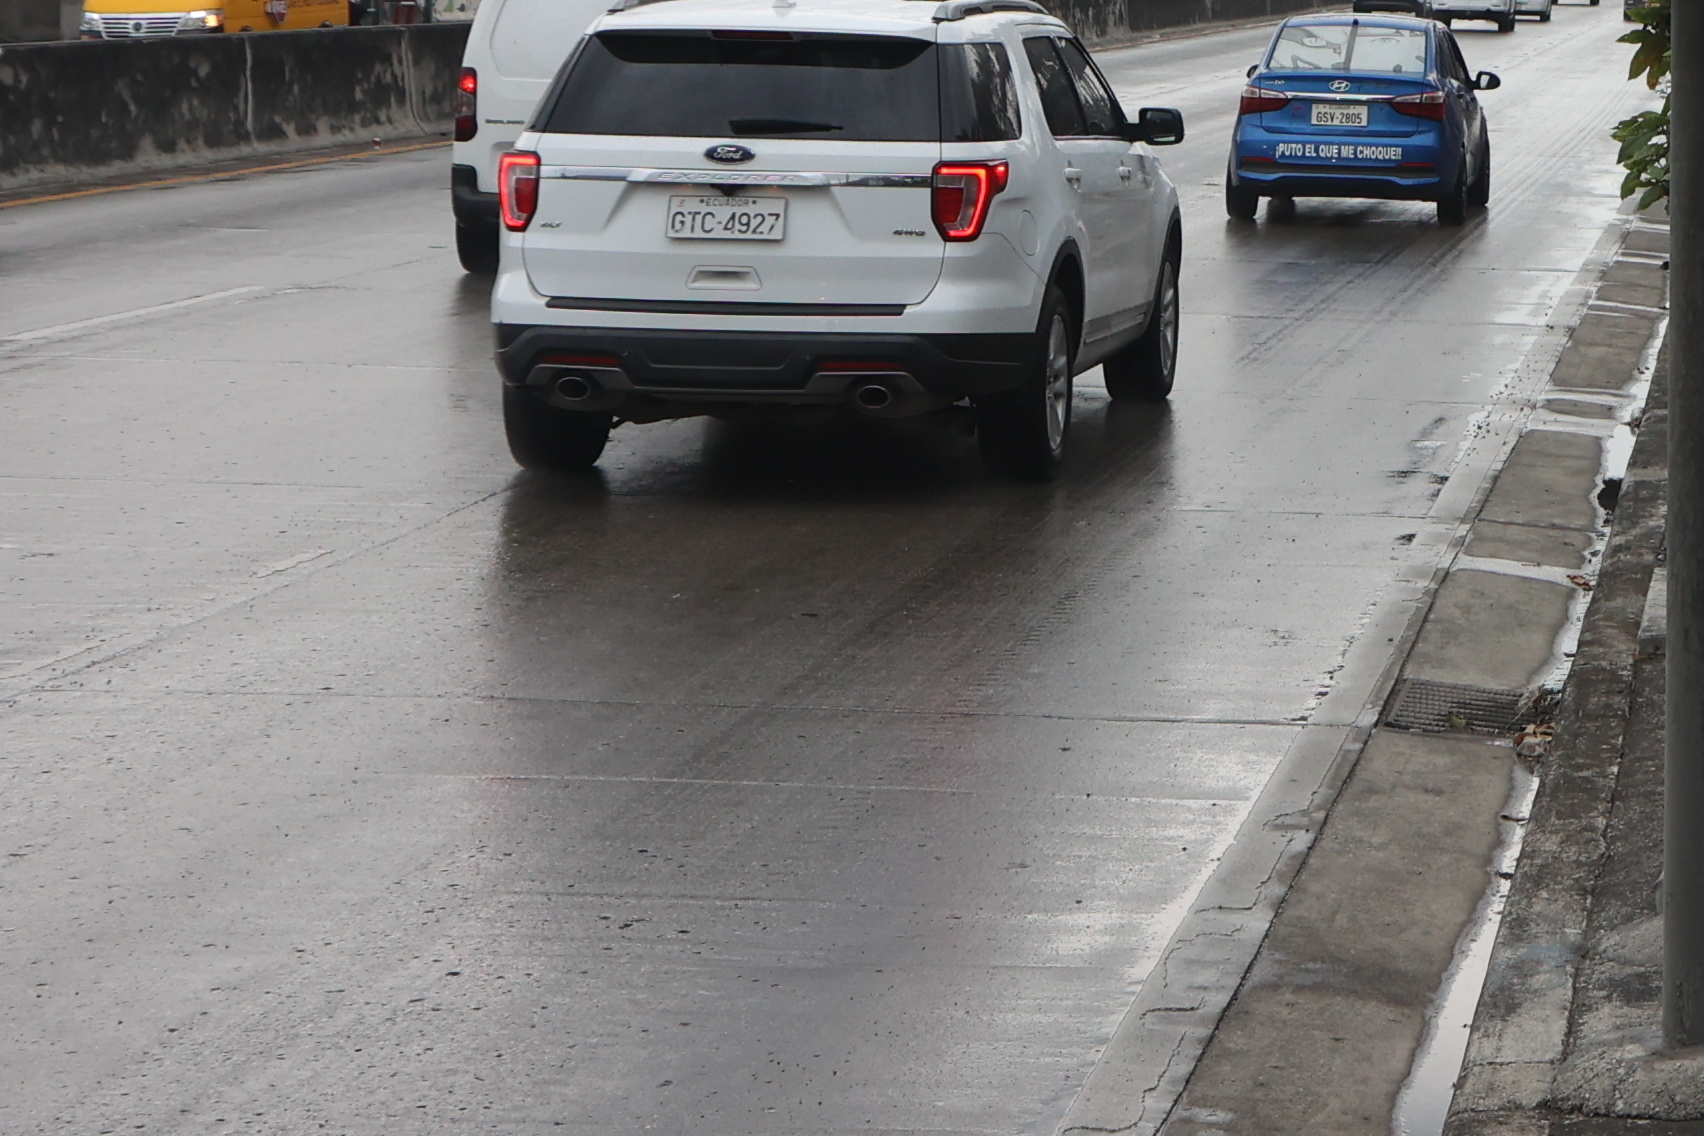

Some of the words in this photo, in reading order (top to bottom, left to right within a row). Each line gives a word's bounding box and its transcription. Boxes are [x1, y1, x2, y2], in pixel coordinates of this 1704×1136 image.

[1316, 111, 1363, 124] GSV-2805
[713, 146, 743, 159] Ford
[1305, 143, 1317, 156] EL
[1318, 144, 1339, 158] QUE
[1340, 146, 1355, 158] ME
[1356, 146, 1402, 160] CHOQUE!!
[657, 171, 797, 183] EXPLORER
[705, 198, 750, 207] ECUADOR
[671, 211, 781, 235] GTC-4927
